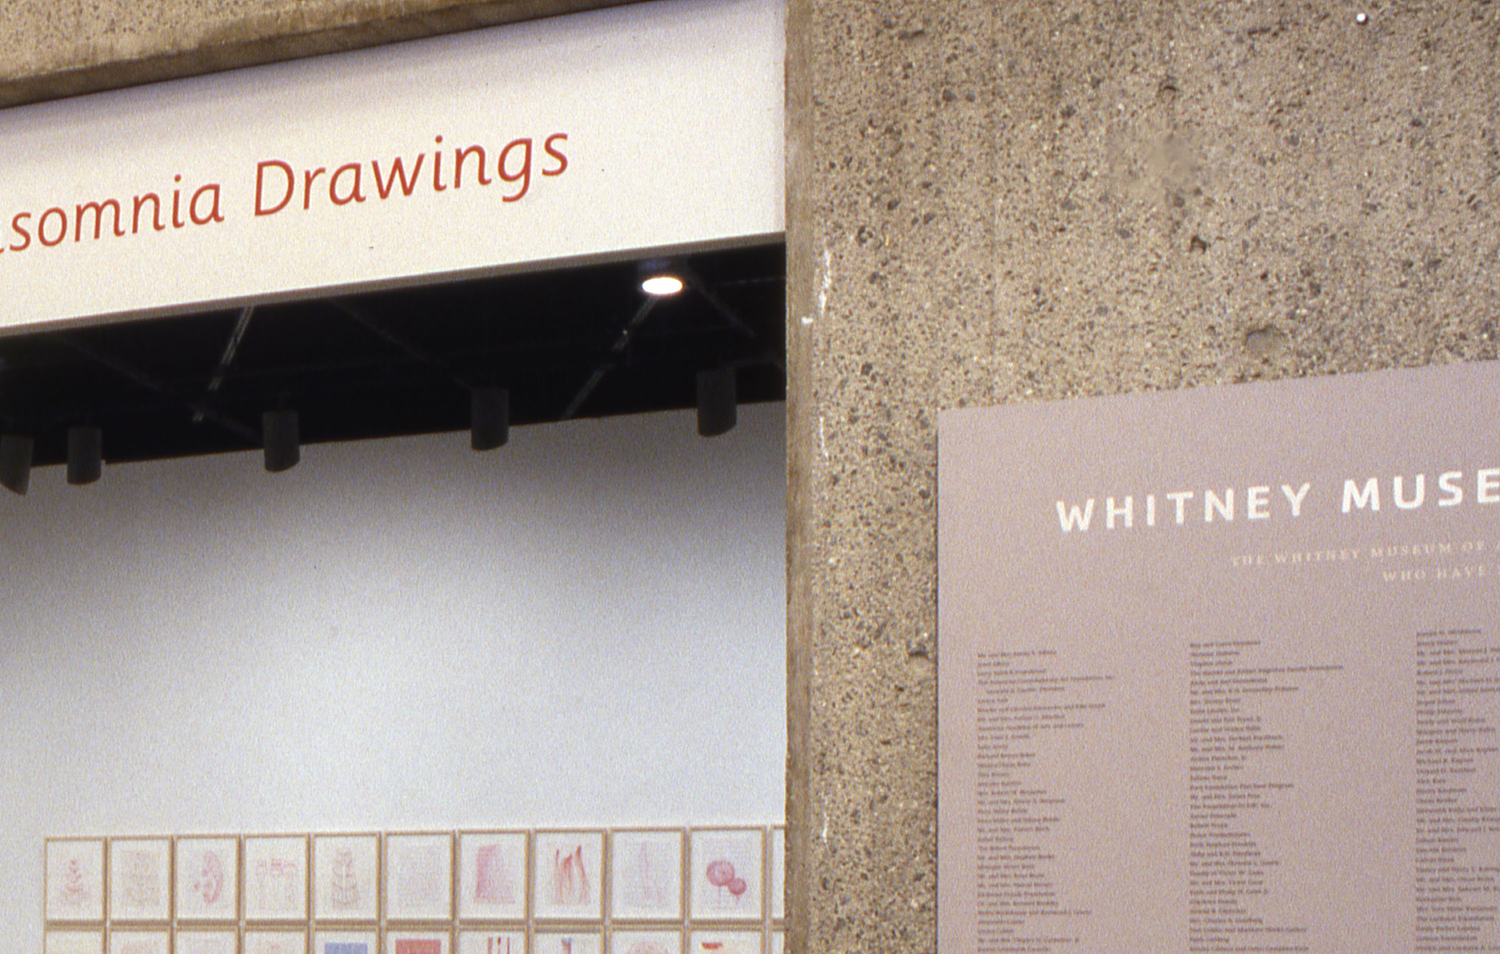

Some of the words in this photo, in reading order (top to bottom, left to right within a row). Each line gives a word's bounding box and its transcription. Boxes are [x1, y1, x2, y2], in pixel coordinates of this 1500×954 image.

[254, 134, 567, 216] Drawings
[1056, 484, 1309, 532] WHITNEY
[1342, 469, 1500, 513] MUSE
[1233, 554, 1263, 566] THE
[1274, 549, 1359, 564] WHITNEY
[1371, 543, 1452, 558] MUSEUM
[1463, 540, 1485, 552] OF
[1383, 570, 1426, 582] WHO
[1436, 565, 1486, 579] HAVE
